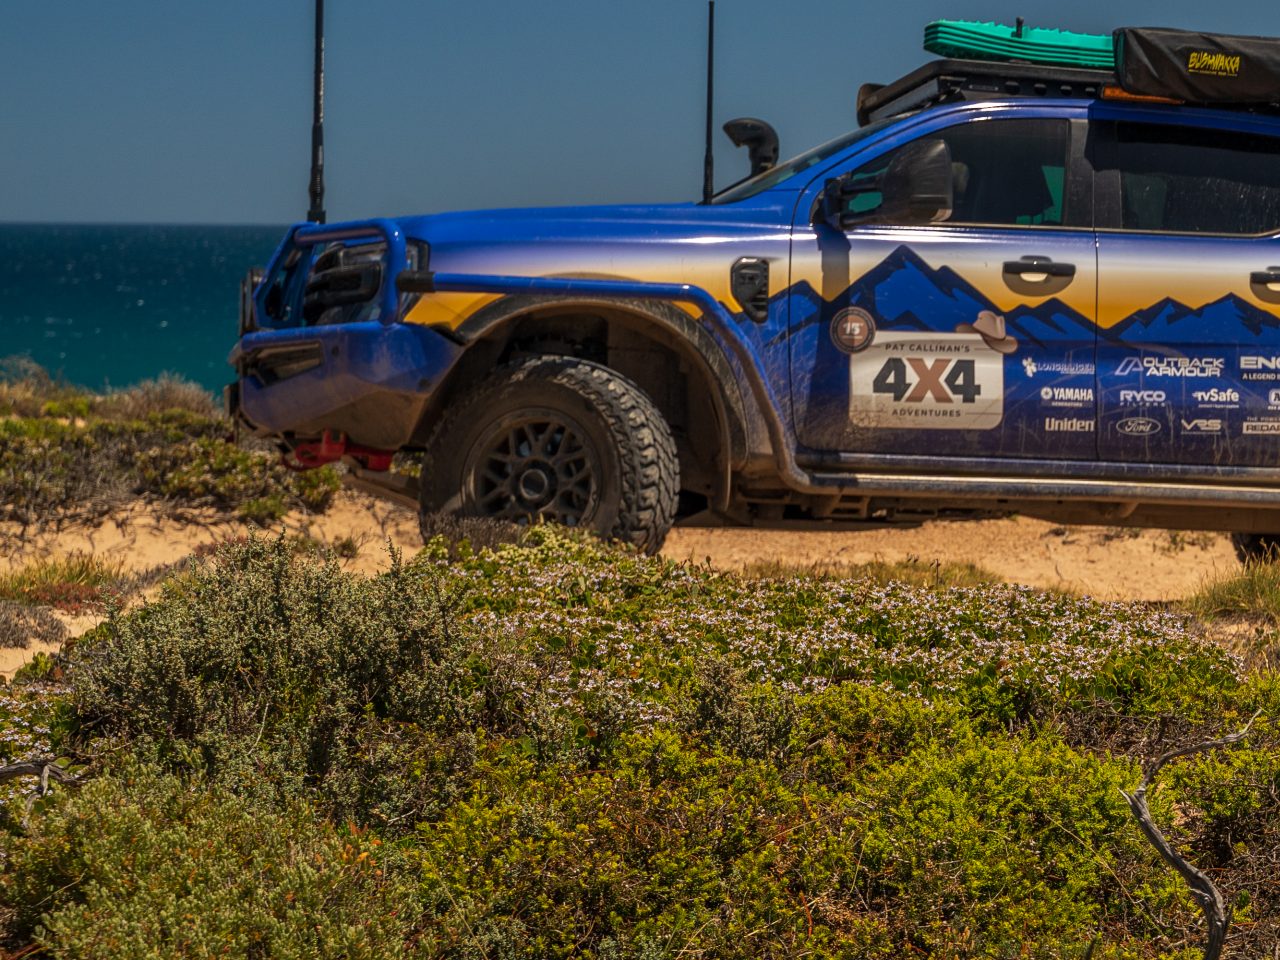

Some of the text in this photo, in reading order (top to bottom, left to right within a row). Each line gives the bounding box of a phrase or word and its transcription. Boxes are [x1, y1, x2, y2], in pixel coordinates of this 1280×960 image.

[885, 343, 970, 353] PAT CALLINAN'S
[1143, 357, 1225, 368] OUTBACK
[1146, 367, 1221, 377] ARMOUR
[873, 357, 981, 404] 4X4
[1053, 387, 1094, 401] YAMAHA
[1120, 390, 1166, 402] RYCO
[1197, 388, 1240, 402] rvSafe
[892, 408, 961, 418] ADVENTURES
[1045, 417, 1095, 432] Uniden
[1125, 420, 1152, 432] Ford
